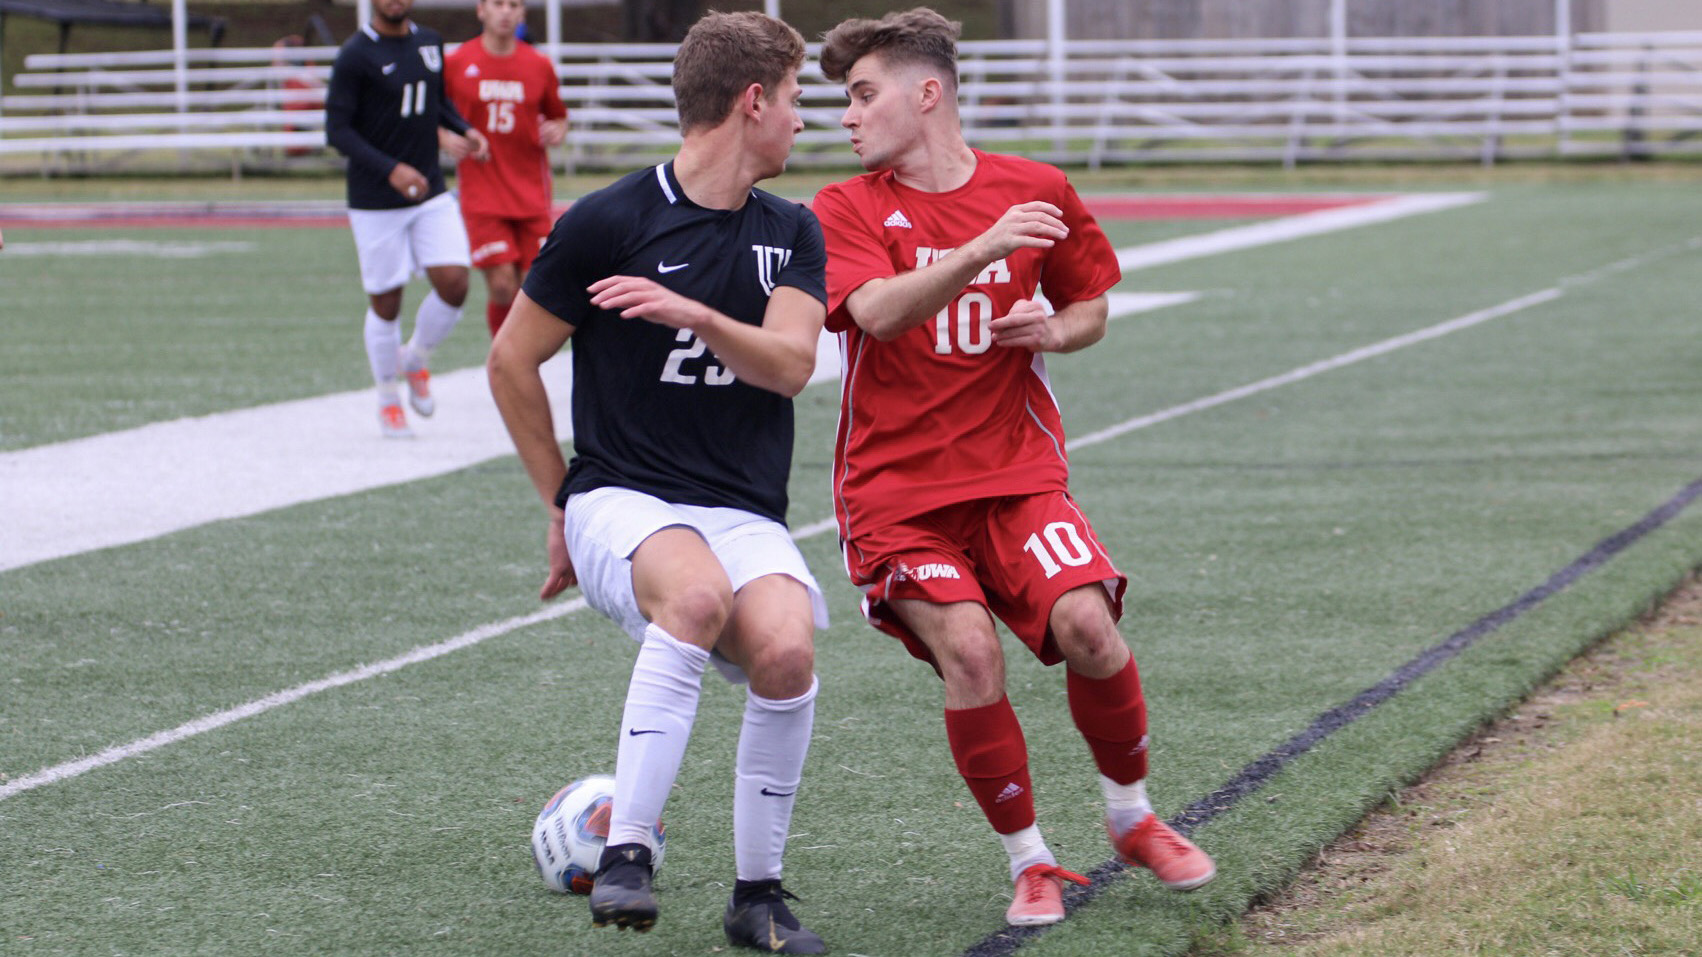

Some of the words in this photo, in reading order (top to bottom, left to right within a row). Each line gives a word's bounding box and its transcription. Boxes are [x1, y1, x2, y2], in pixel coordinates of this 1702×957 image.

[400, 79, 427, 118] 11
[486, 102, 515, 133] 15
[884, 220, 913, 229] adidas
[915, 246, 1011, 285] UA
[935, 292, 993, 354] 10
[1023, 521, 1093, 580] 10
[918, 563, 961, 581] UWA
